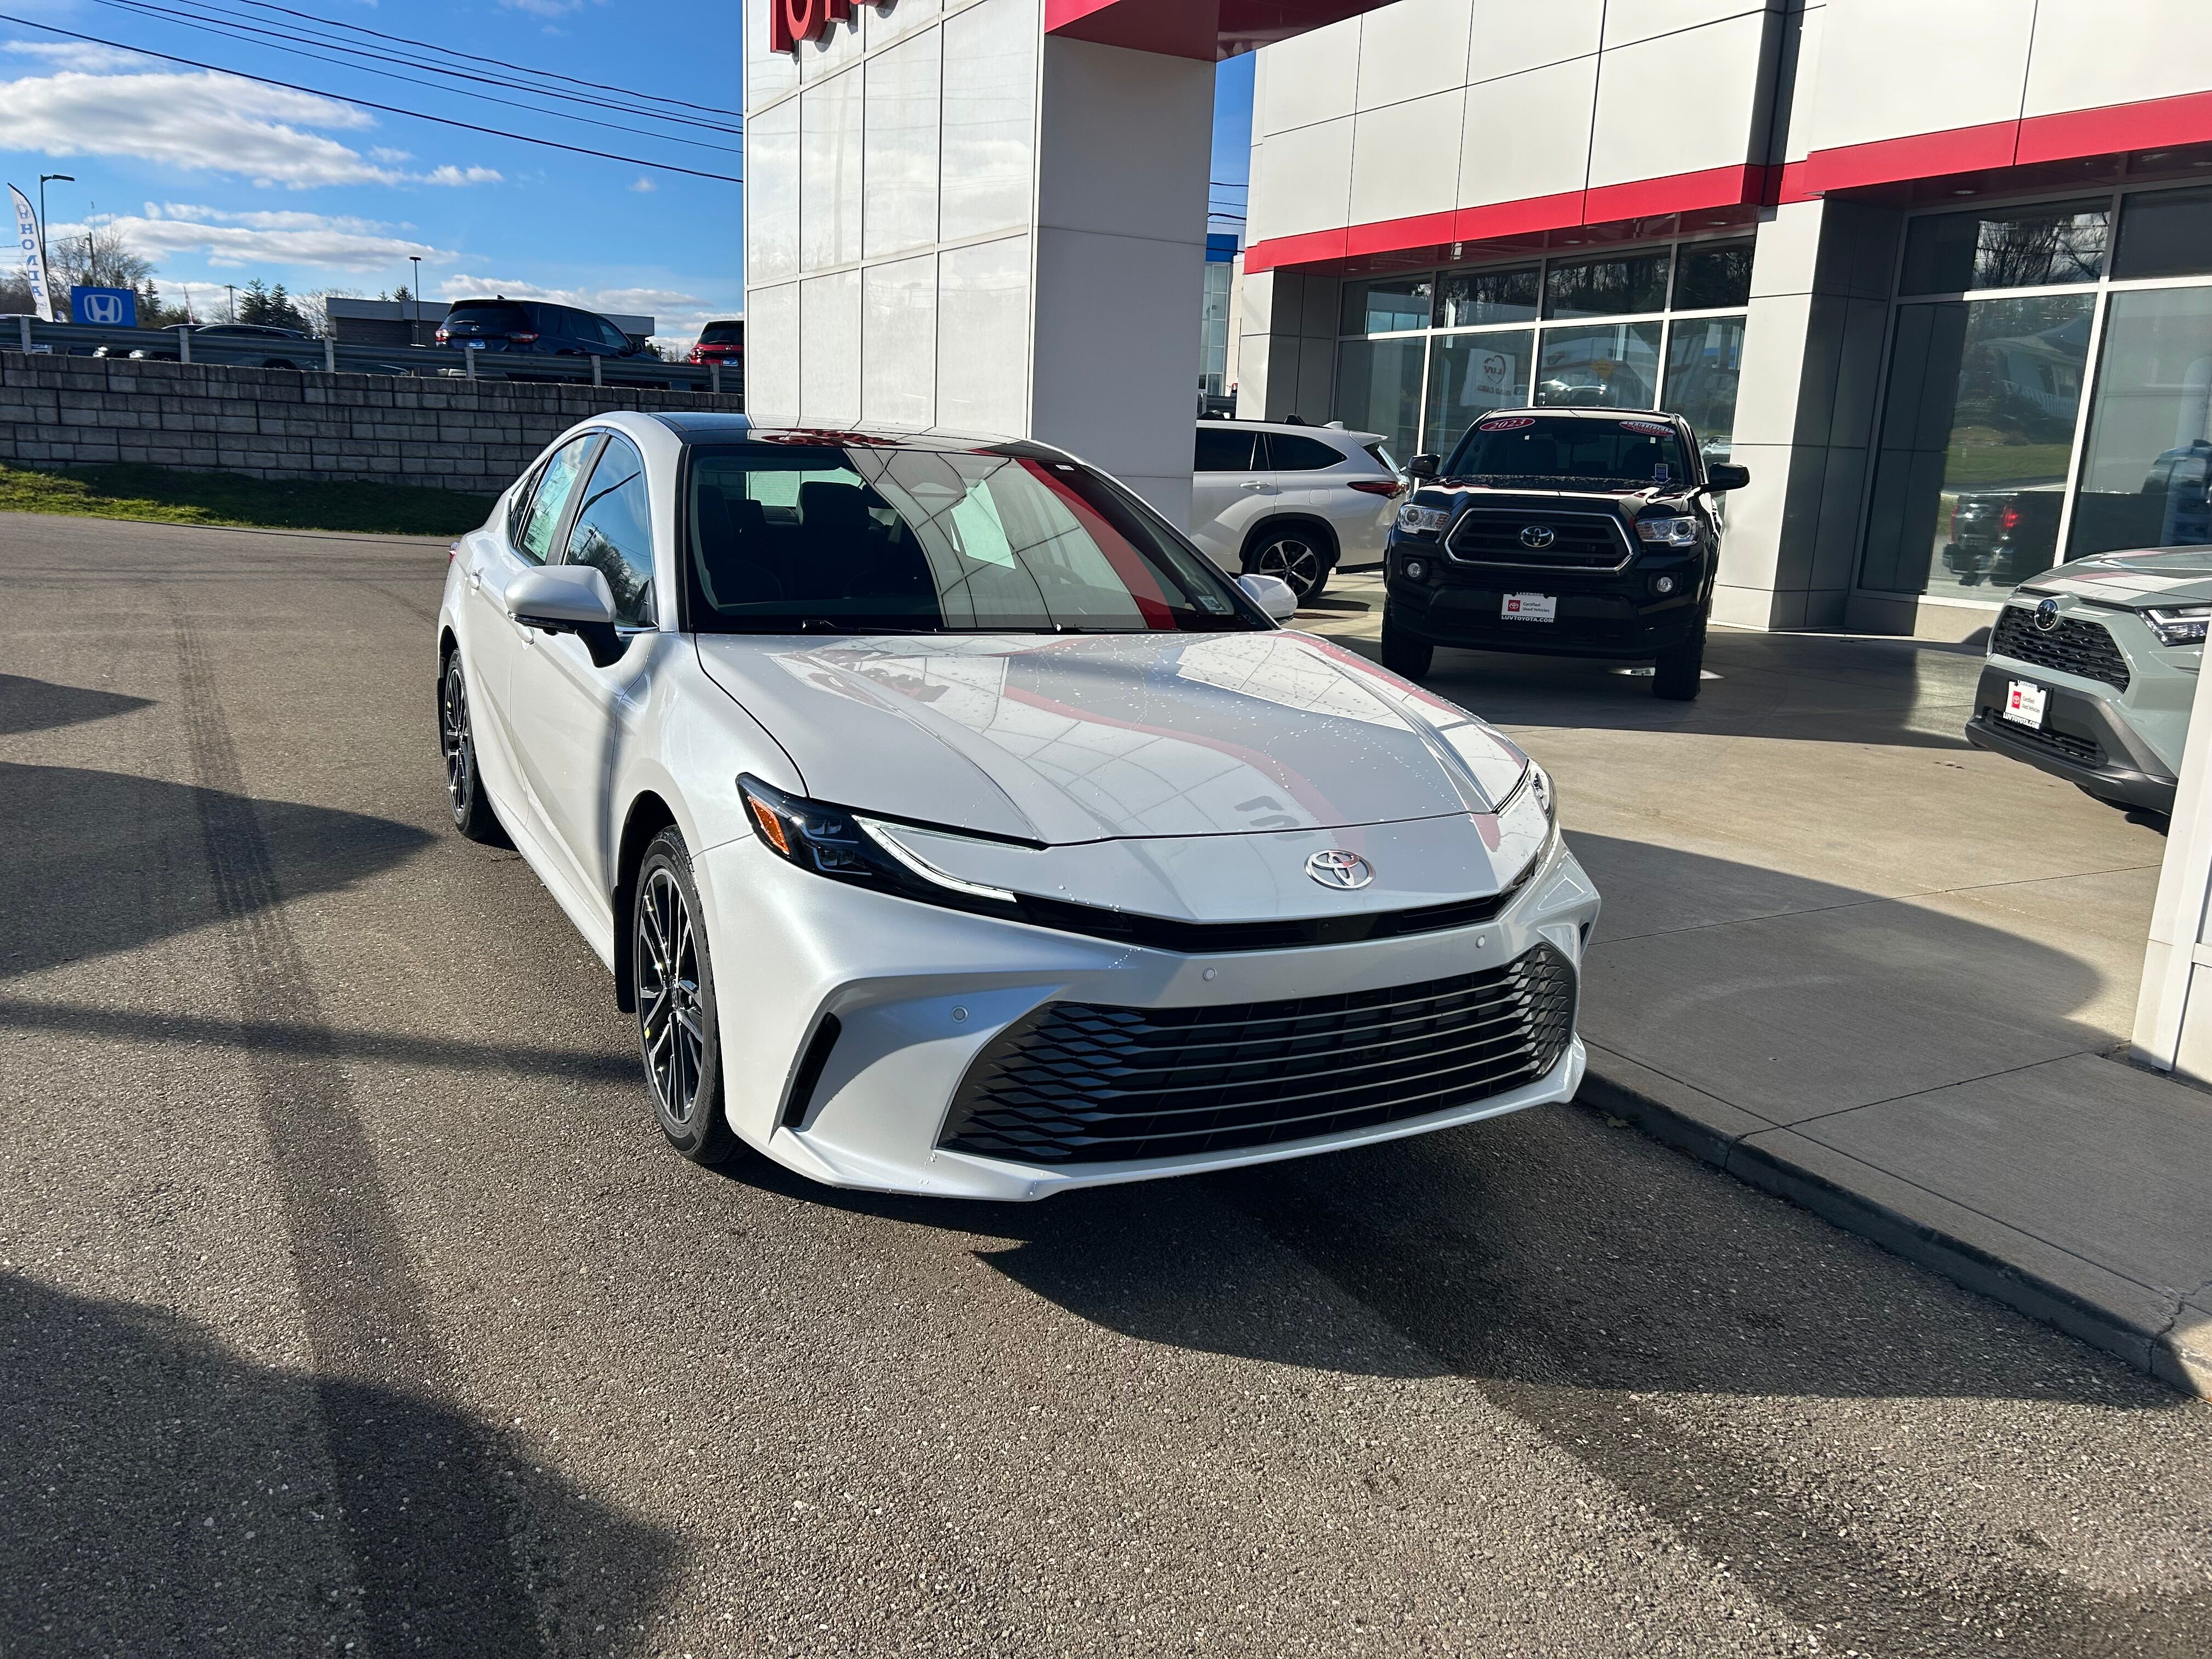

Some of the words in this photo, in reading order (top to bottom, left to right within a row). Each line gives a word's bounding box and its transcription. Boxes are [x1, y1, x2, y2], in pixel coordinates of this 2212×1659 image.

[1488, 419, 1526, 430] 2023
[1627, 421, 1670, 432] CERTIFIED
[1501, 615, 1554, 623] LUVTOYOTA.COM
[2002, 712, 2040, 730] LUVTOYOTA.COM
